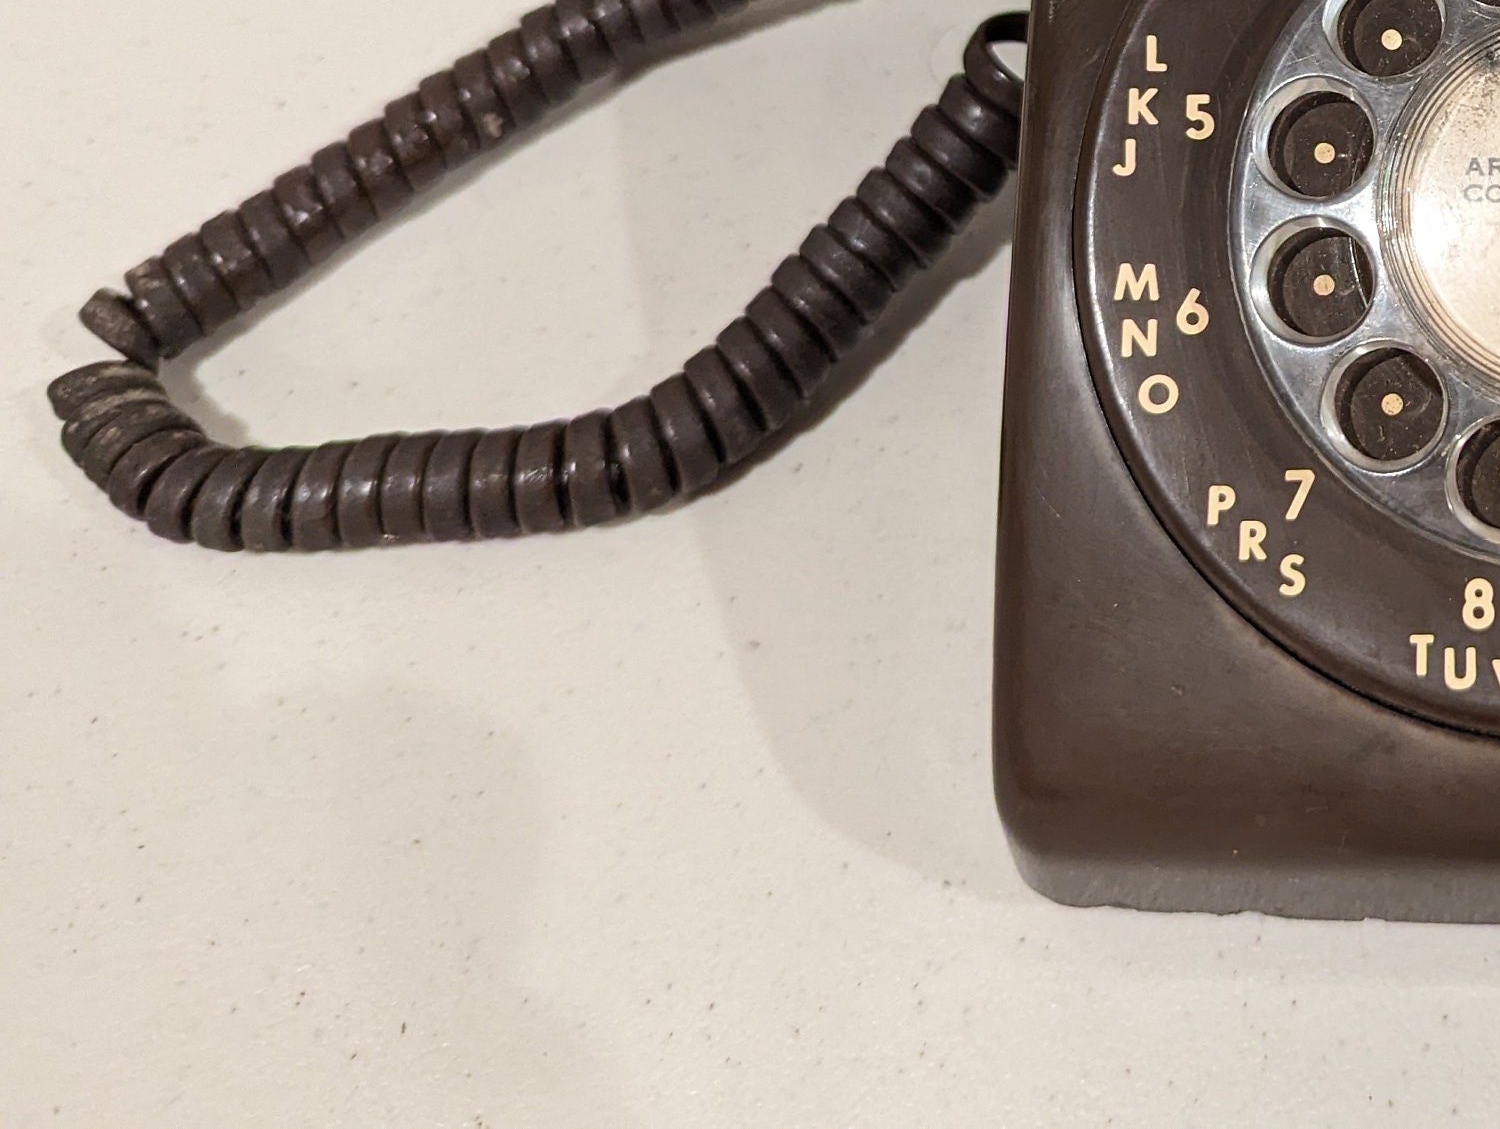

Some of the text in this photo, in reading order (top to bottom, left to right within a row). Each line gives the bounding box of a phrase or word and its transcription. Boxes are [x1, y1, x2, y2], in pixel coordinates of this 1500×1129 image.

[1185, 93, 1215, 141] 5
[1175, 287, 1210, 336] 6
[1284, 469, 1316, 521] 7
[1461, 577, 1496, 631] 8
